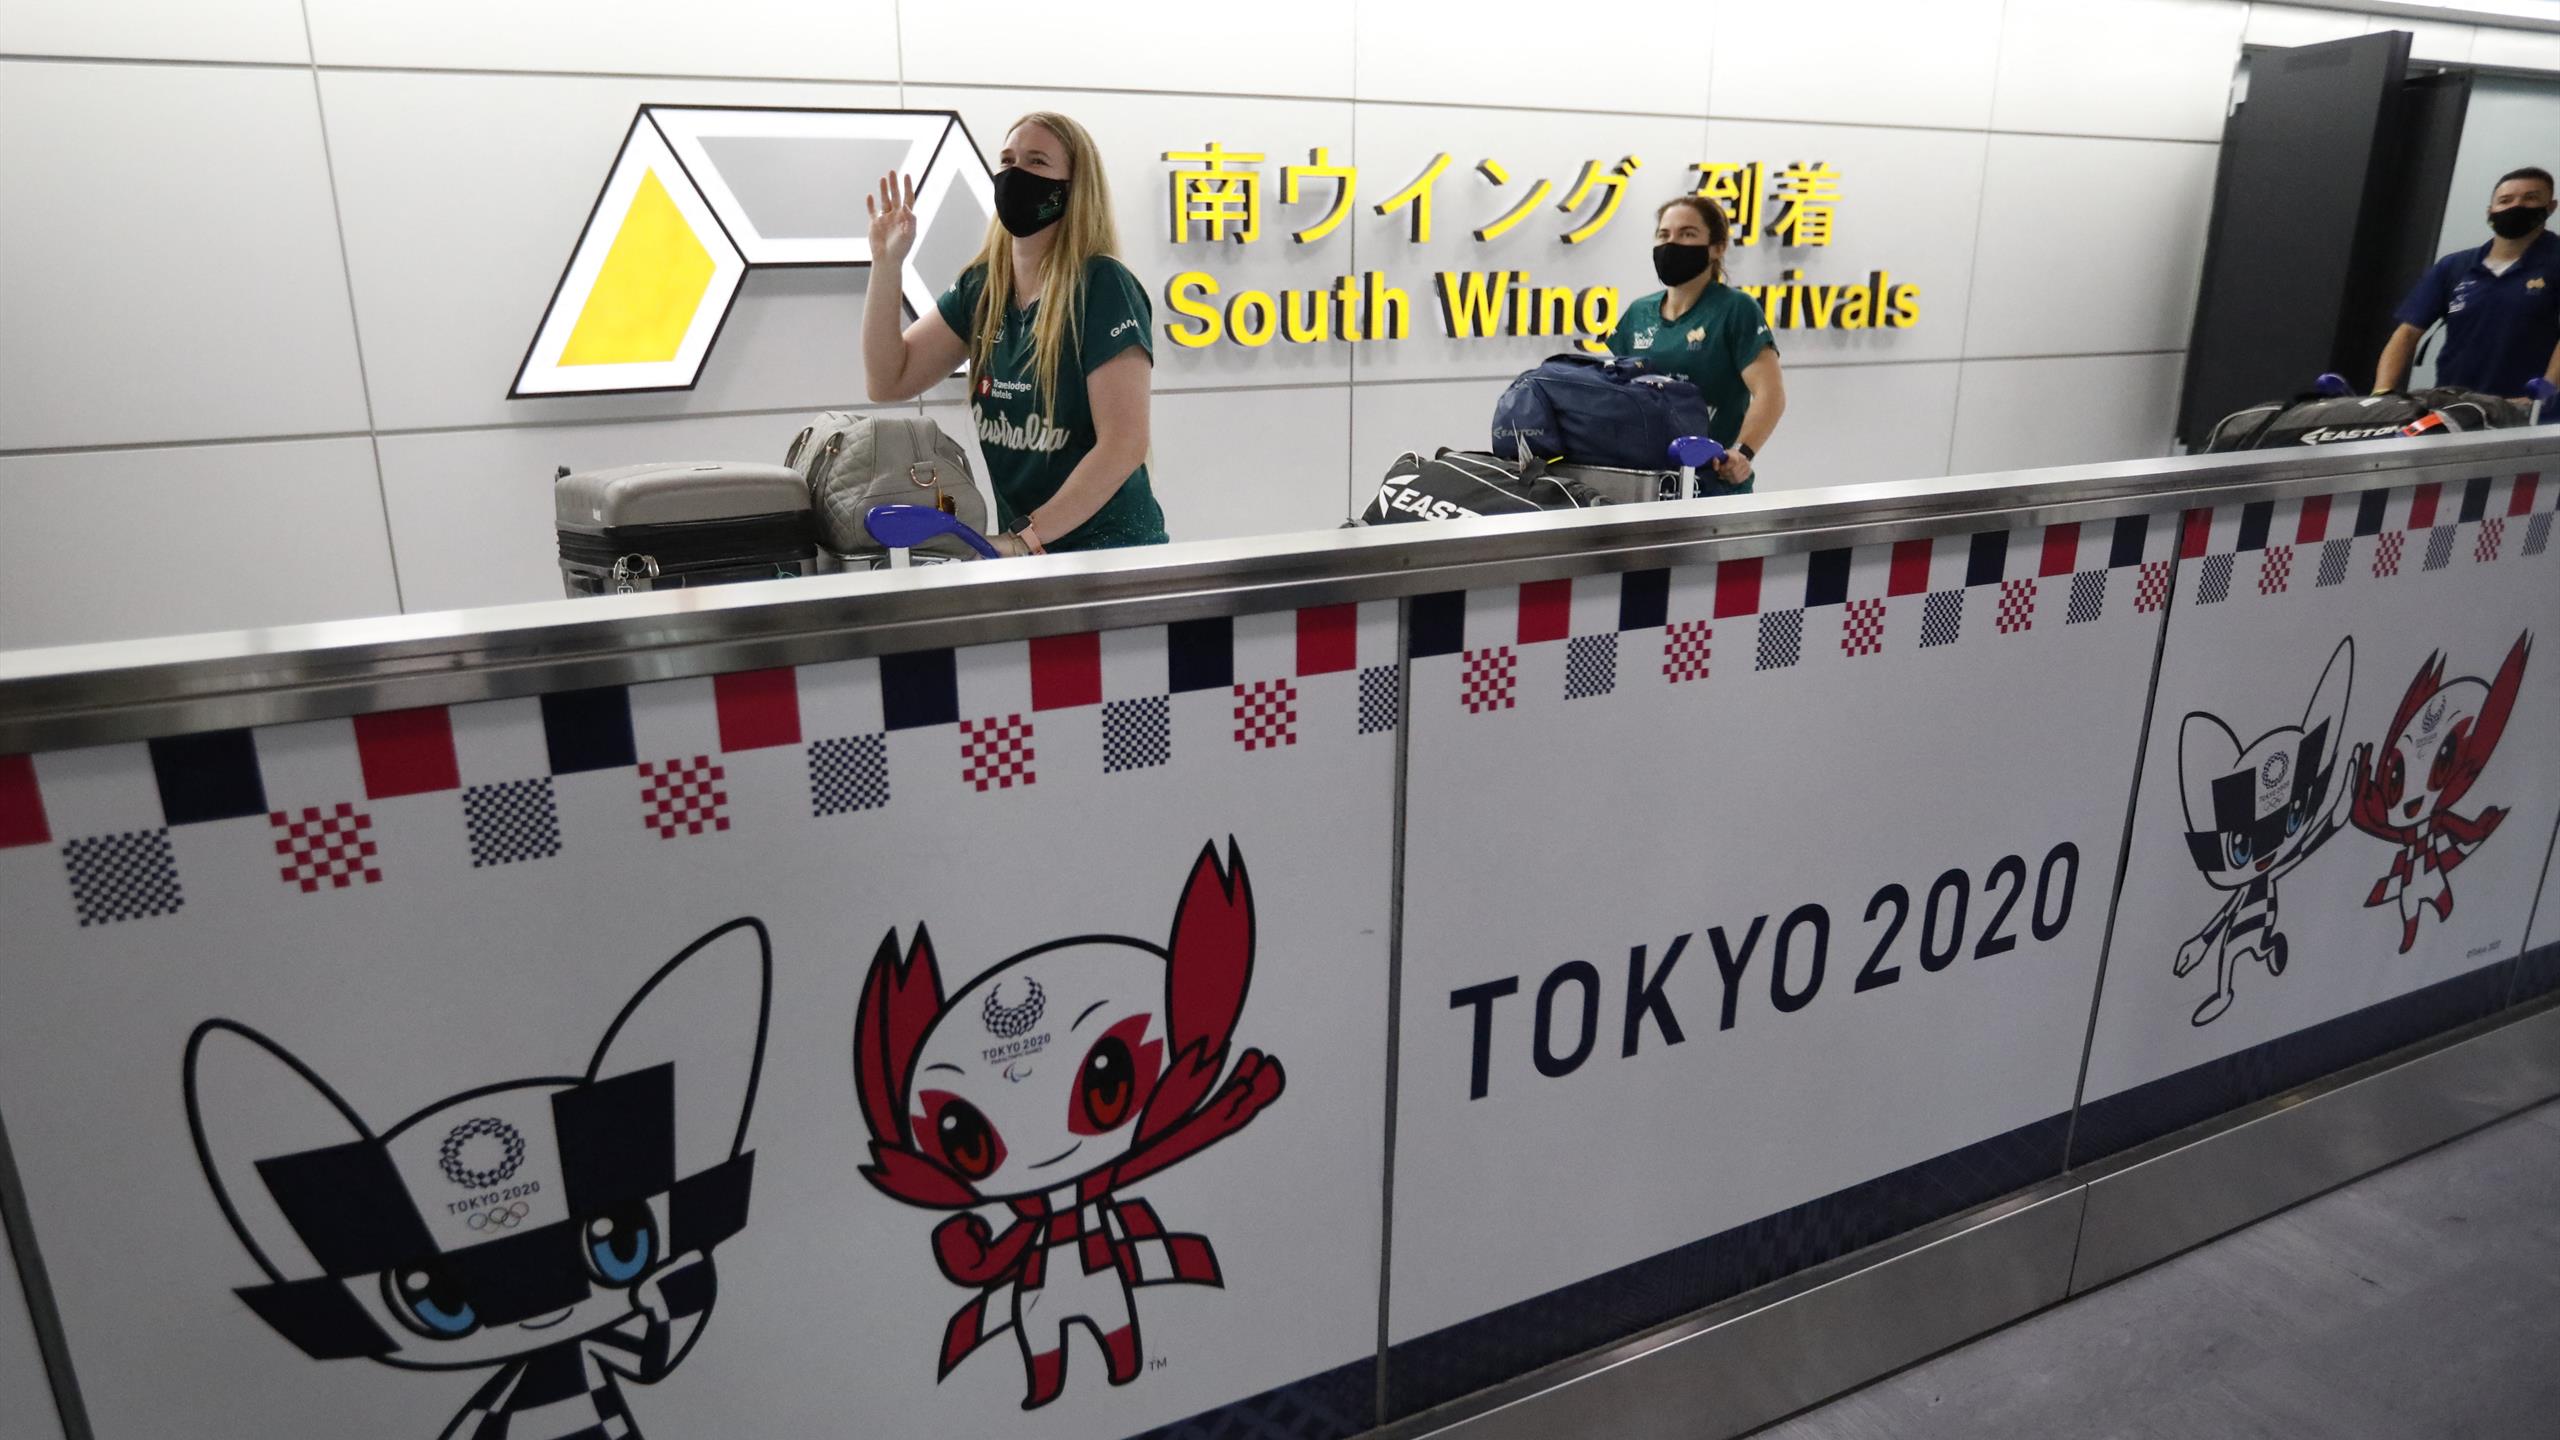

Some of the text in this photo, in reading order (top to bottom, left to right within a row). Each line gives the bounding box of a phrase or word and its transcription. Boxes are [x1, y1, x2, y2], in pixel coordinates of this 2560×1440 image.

[1163, 143, 1843, 247] 南ウイング 到着
[1165, 269, 1921, 352] South Wing rivals
[1501, 428, 1545, 437] EATON
[1449, 841, 2080, 1101] TOKYO 2020
[982, 1042, 1020, 1061] TOKYO
[1023, 1033, 1051, 1049] 2020
[448, 1181, 541, 1215] TOKYO 2020
